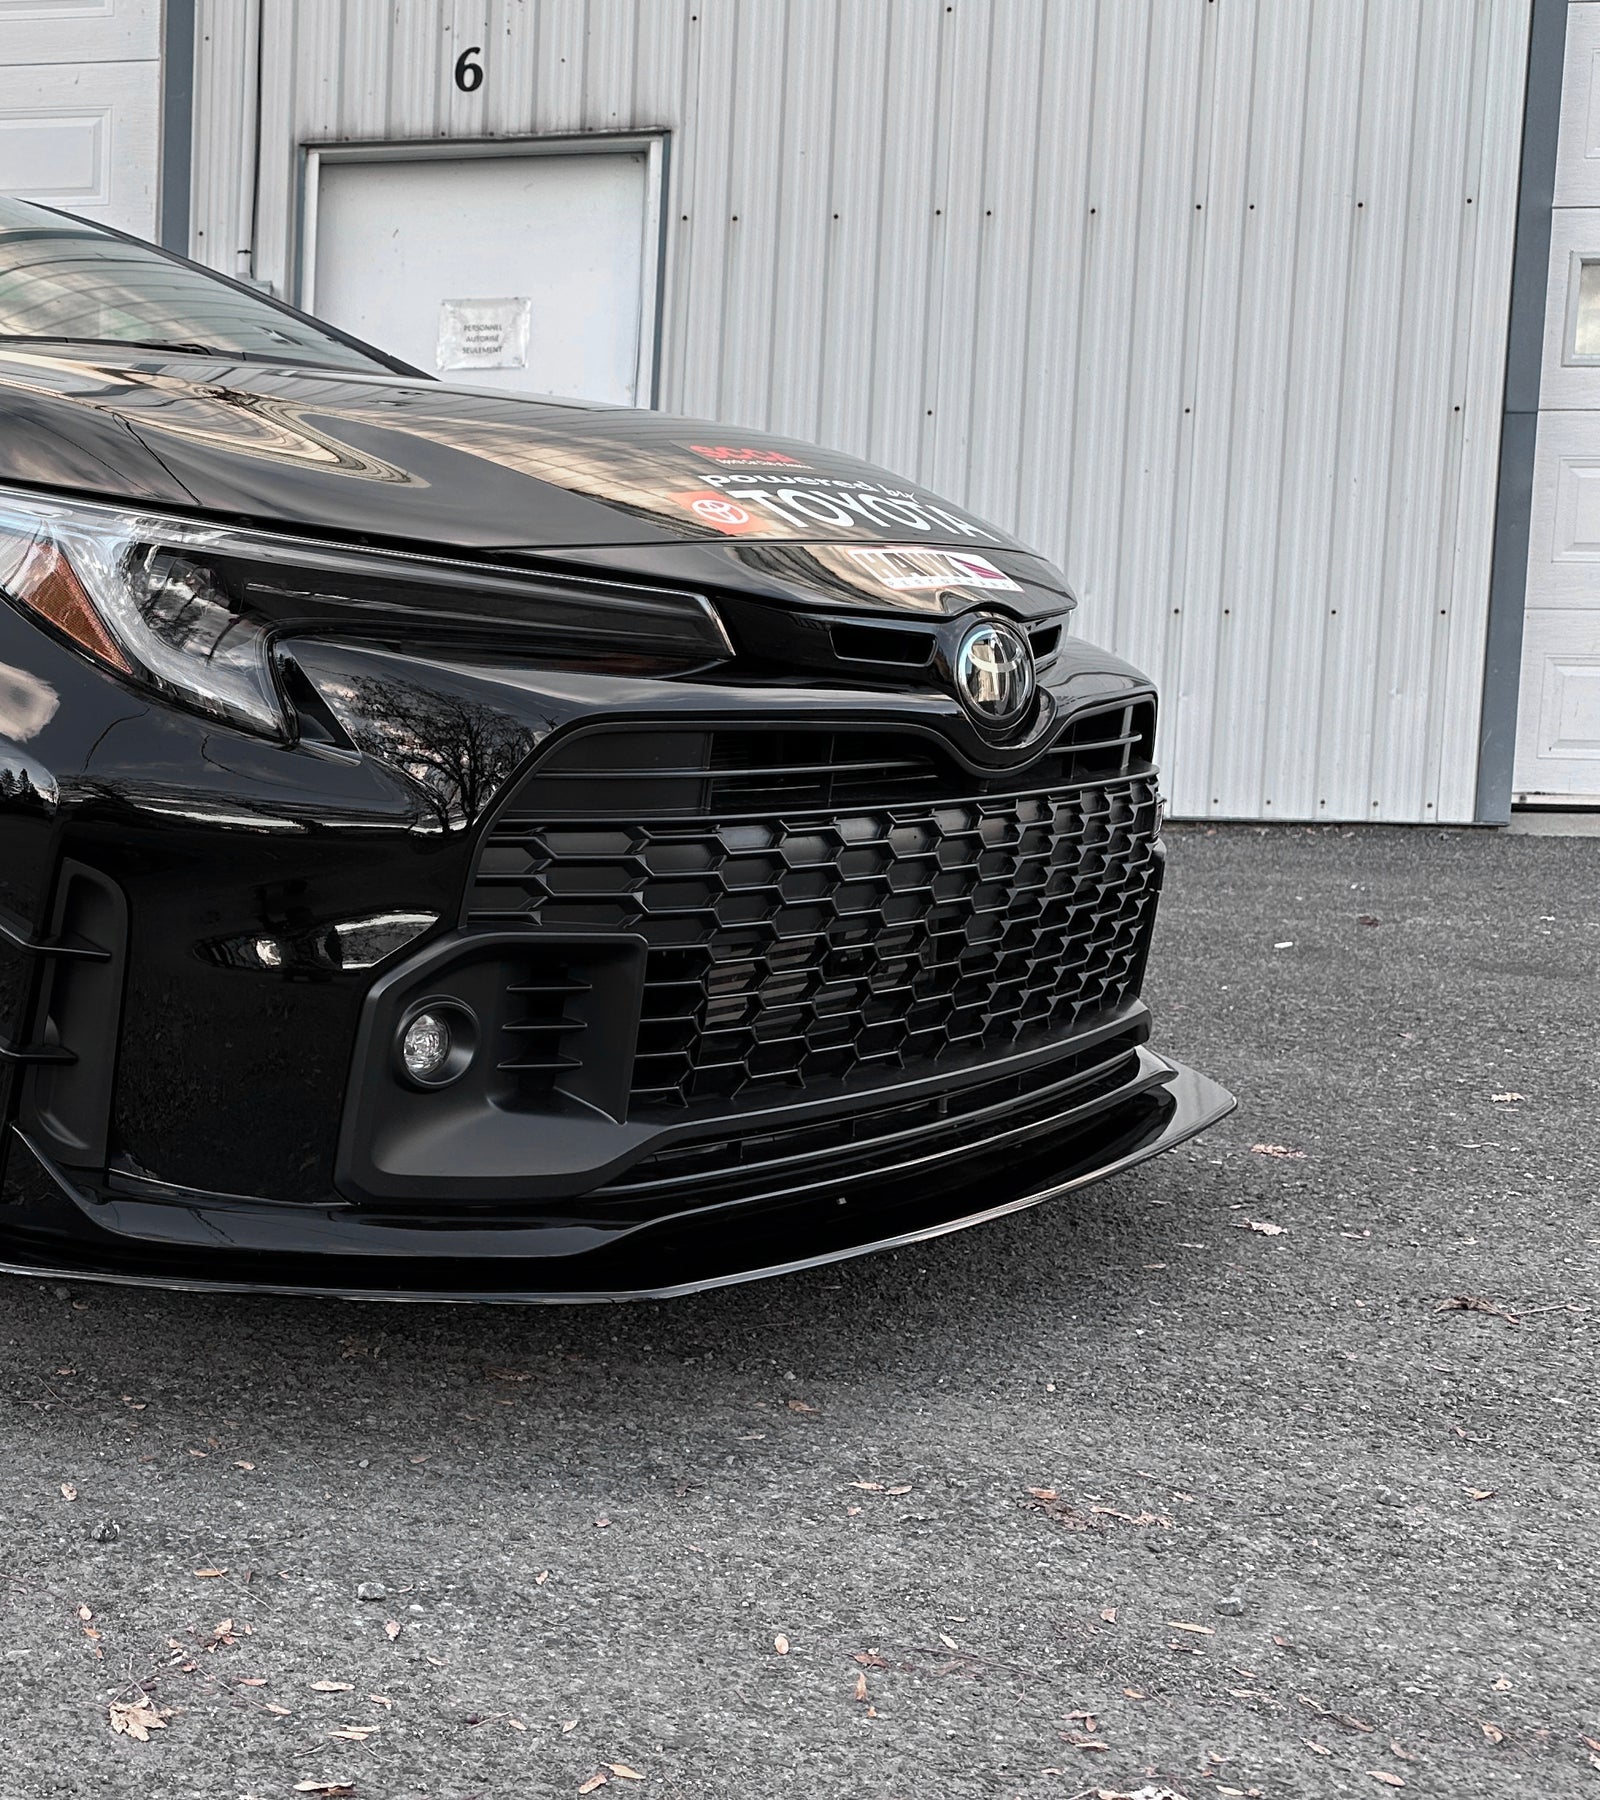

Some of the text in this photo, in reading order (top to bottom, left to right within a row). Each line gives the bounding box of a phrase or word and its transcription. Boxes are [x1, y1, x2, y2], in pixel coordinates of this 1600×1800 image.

[455, 46, 484, 92] 6
[689, 445, 802, 464] SCCA
[698, 474, 920, 504] powered by
[725, 488, 1002, 543] TOYOTA
[853, 552, 973, 579] HAWK
